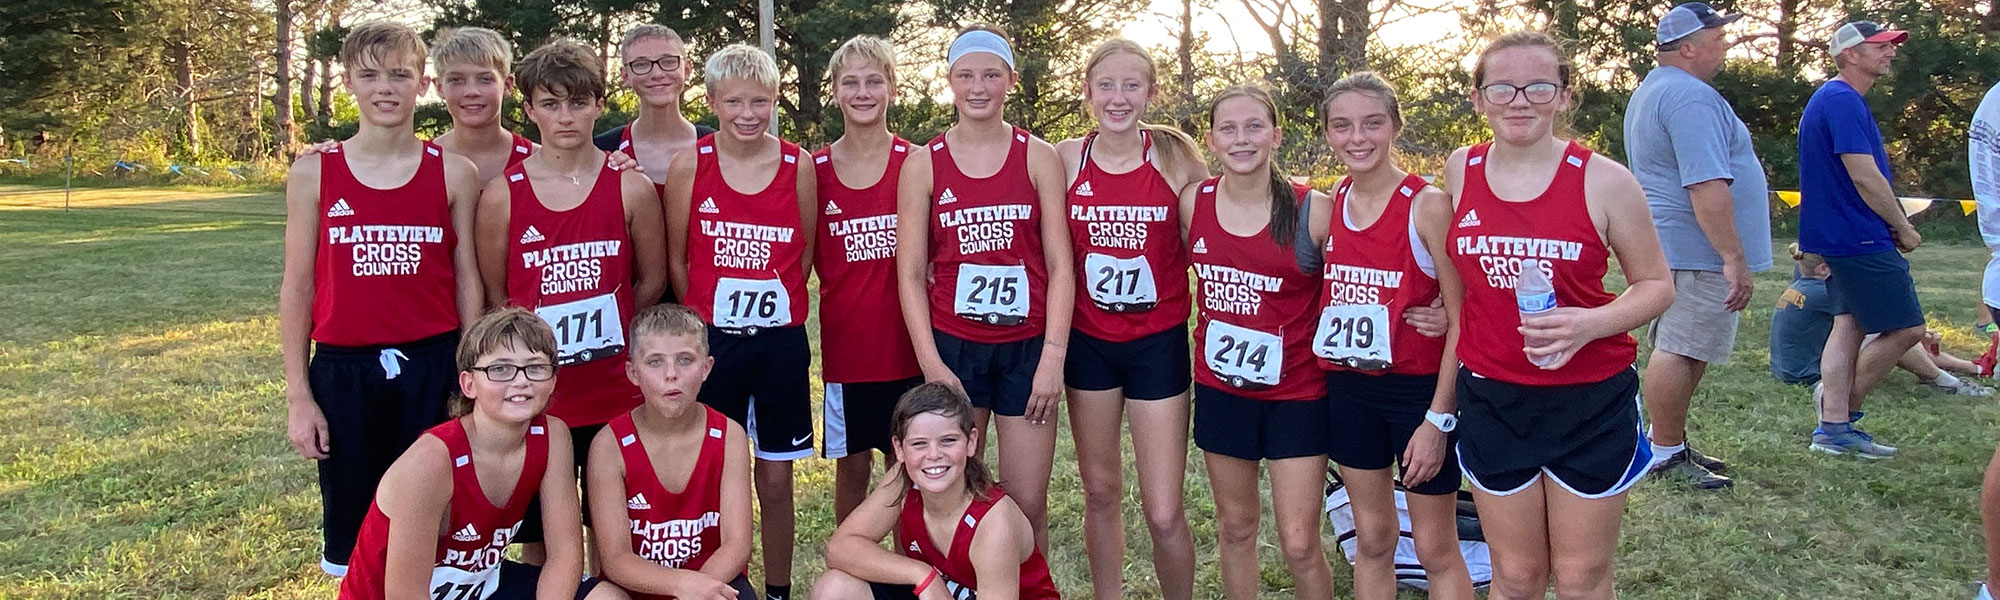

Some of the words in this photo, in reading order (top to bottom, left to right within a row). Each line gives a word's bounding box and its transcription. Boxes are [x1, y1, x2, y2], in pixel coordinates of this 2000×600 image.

[328, 209, 355, 218] adidas
[939, 204, 1032, 228] PLATTEVIEW
[1071, 204, 1168, 222] PLATTEVIEW
[329, 225, 443, 244] PLATTEVIEW
[828, 213, 898, 237] PLATTEVIE
[957, 221, 1014, 243] CROSS
[1088, 222, 1148, 239] CROSS
[714, 238, 771, 259] CROSS
[844, 230, 897, 251] CROSS
[959, 238, 1014, 255] COUNTRY
[1090, 236, 1146, 250] COUNTRY
[1457, 235, 1583, 261] PLATTEVIEW
[352, 243, 421, 263] CROSS
[522, 240, 621, 268] PLATTEVIEW
[714, 255, 769, 270] COUNTRY
[846, 246, 897, 262] COUNTRY
[353, 261, 420, 277] COUNTRY
[541, 259, 601, 282] CROSS
[1324, 263, 1403, 288] LATTEVIEW
[1479, 255, 1554, 279] CROS
[541, 276, 600, 295] COUNTRY
[967, 276, 1018, 306] 215
[1096, 266, 1140, 295] 217
[1204, 280, 1261, 303] CROSS
[1331, 281, 1379, 304] CROSS
[728, 290, 778, 318] 176
[1205, 297, 1260, 315] COUNTRY
[556, 308, 602, 345] 171
[1323, 316, 1374, 349] 219
[1214, 335, 1268, 372] 214
[452, 534, 481, 542] adidas
[640, 536, 701, 560] CROSS
